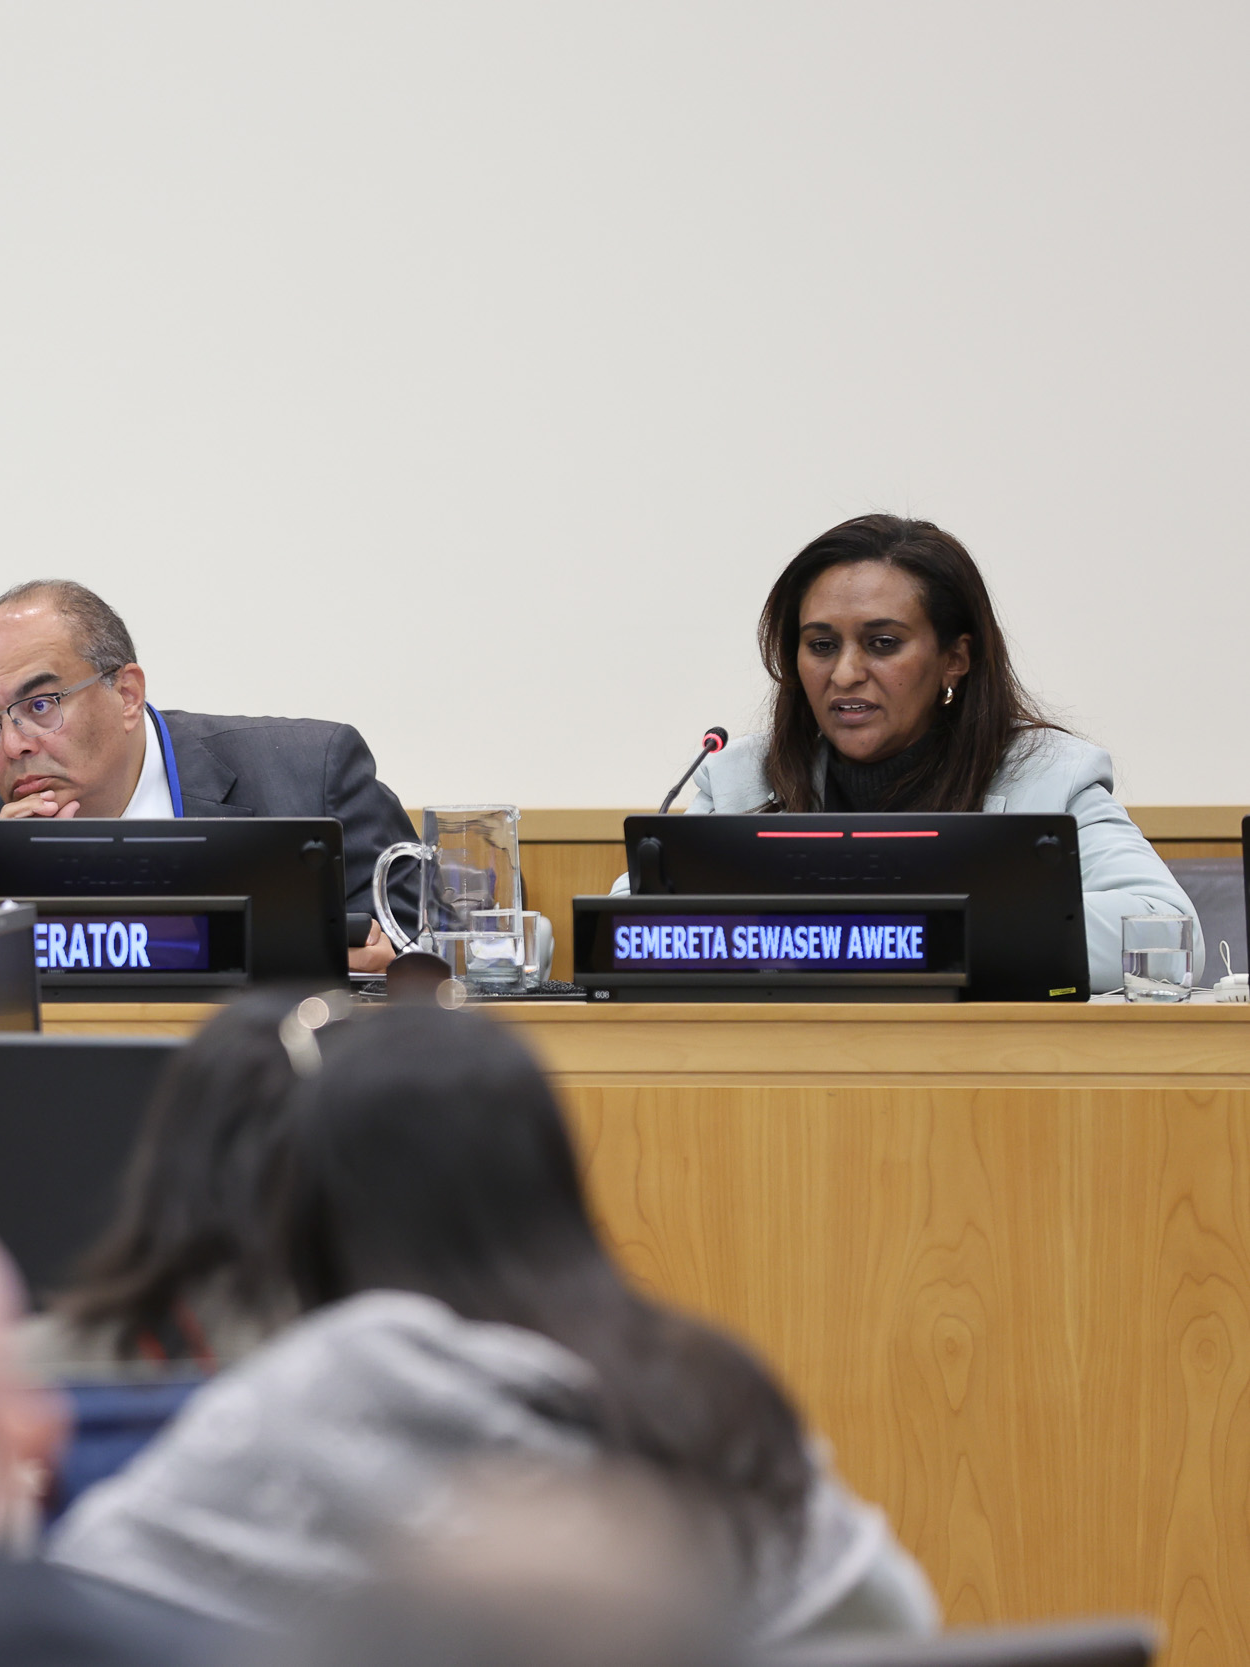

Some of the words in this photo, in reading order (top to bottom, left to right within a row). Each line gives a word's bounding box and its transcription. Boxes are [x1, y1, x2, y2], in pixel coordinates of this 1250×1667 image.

[35, 921, 151, 968] ERATOR
[615, 925, 728, 960] SEMERETA
[732, 925, 842, 960] SEWASEW
[847, 925, 923, 960] AWEKE
